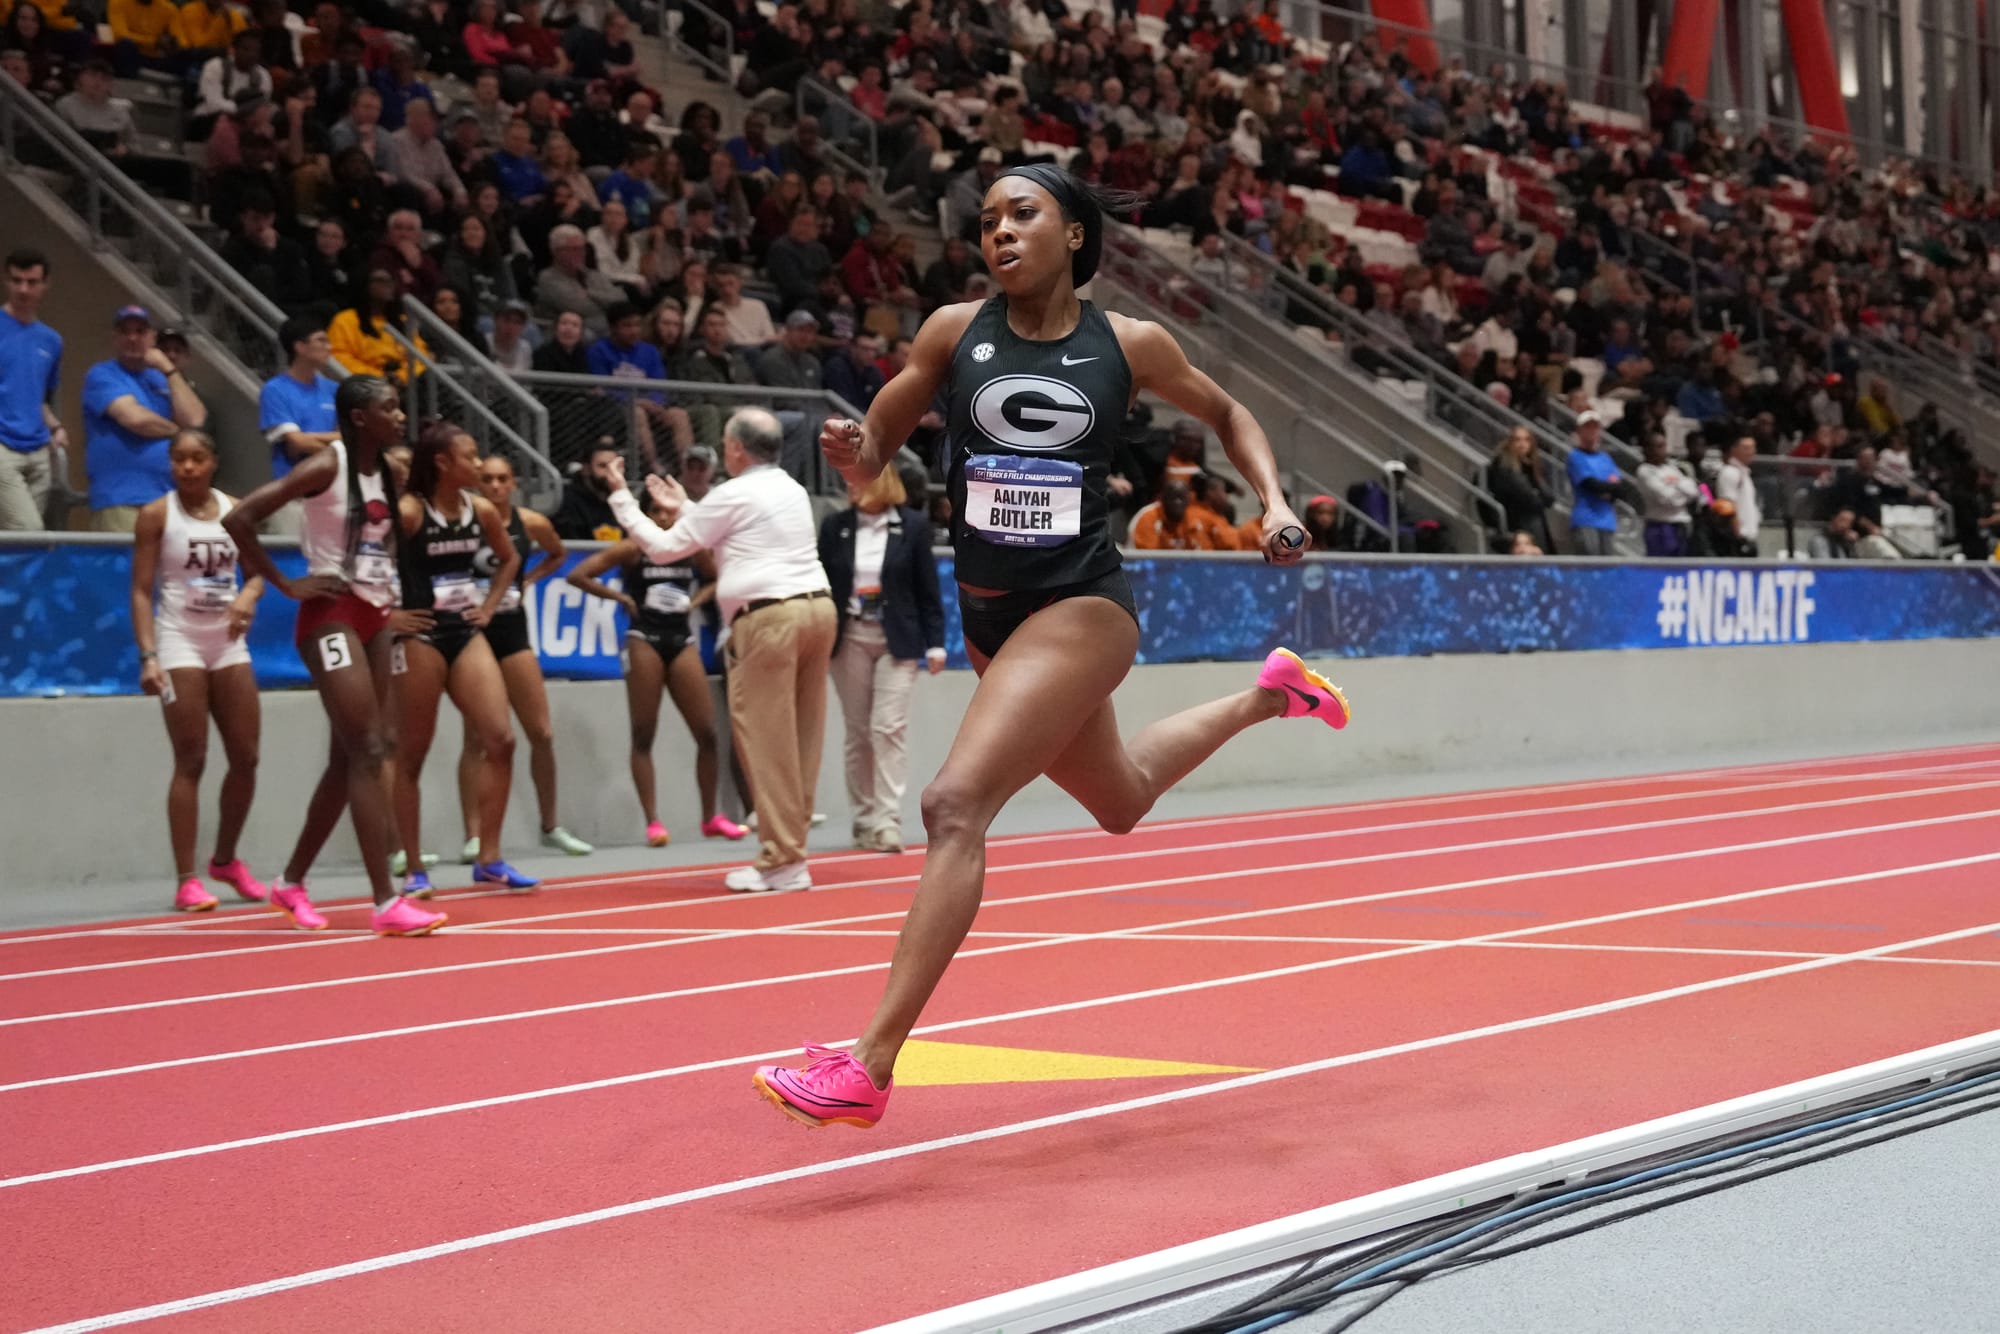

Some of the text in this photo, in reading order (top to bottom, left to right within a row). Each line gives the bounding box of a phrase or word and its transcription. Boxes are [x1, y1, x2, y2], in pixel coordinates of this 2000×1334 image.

[972, 343, 995, 362] SEC
[972, 375, 1093, 450] G
[986, 471, 1003, 479] TRACK
[1008, 472, 1024, 480] FIELD
[1024, 473, 1073, 482] CHAMPIONSHIPS
[994, 488, 1050, 507] AALIYAH
[989, 507, 1053, 530] BUTLER
[1656, 569, 1816, 644] #NCAATF
[326, 637, 343, 666] 5
